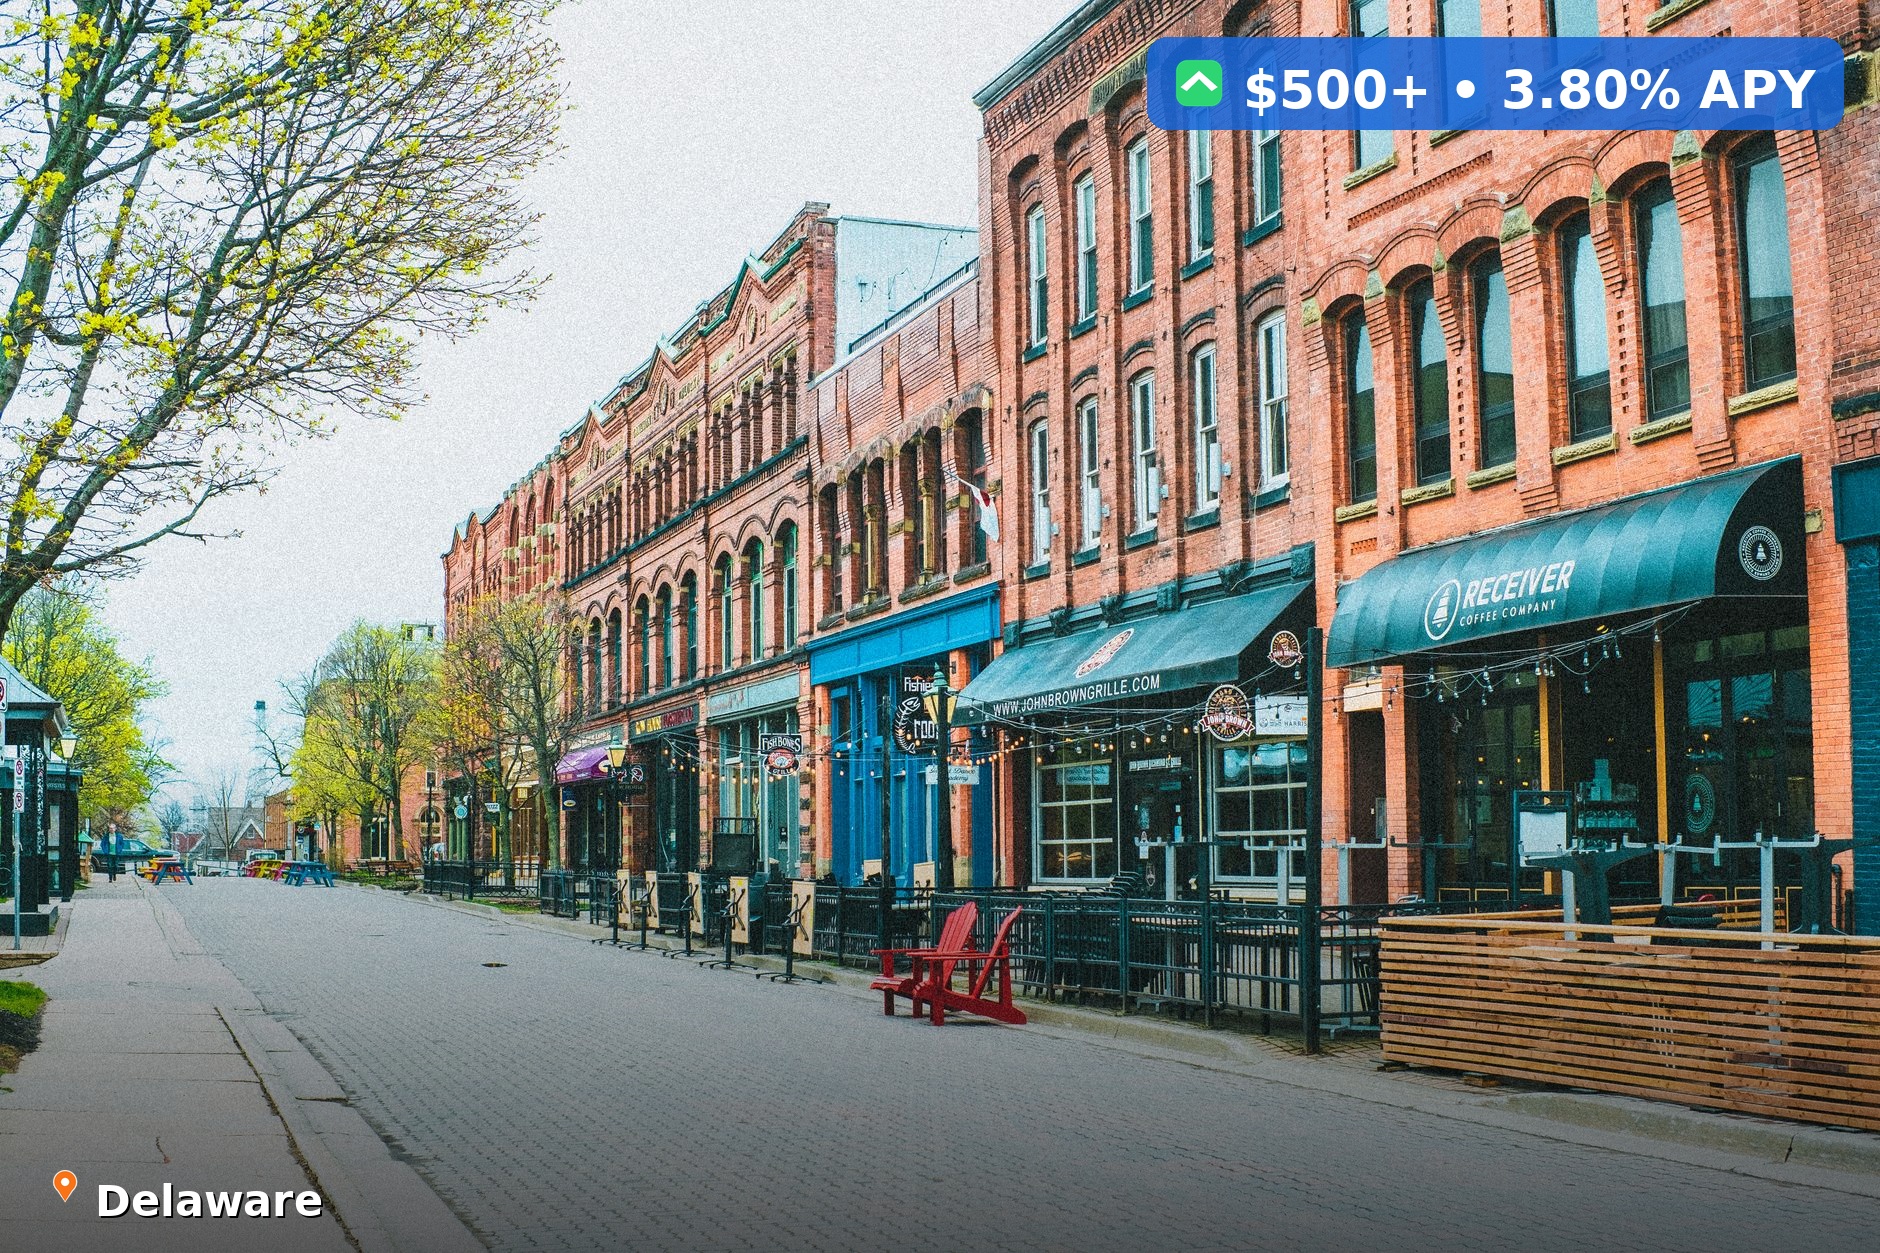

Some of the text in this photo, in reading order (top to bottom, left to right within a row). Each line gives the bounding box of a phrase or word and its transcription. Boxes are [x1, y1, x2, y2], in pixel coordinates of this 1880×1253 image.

[1462, 560, 1576, 609] RECEIVER
[1460, 599, 1556, 627] COFFEE COMPANY
[993, 674, 1160, 716] WWW.JOHNBROWNGRILLE.COM
